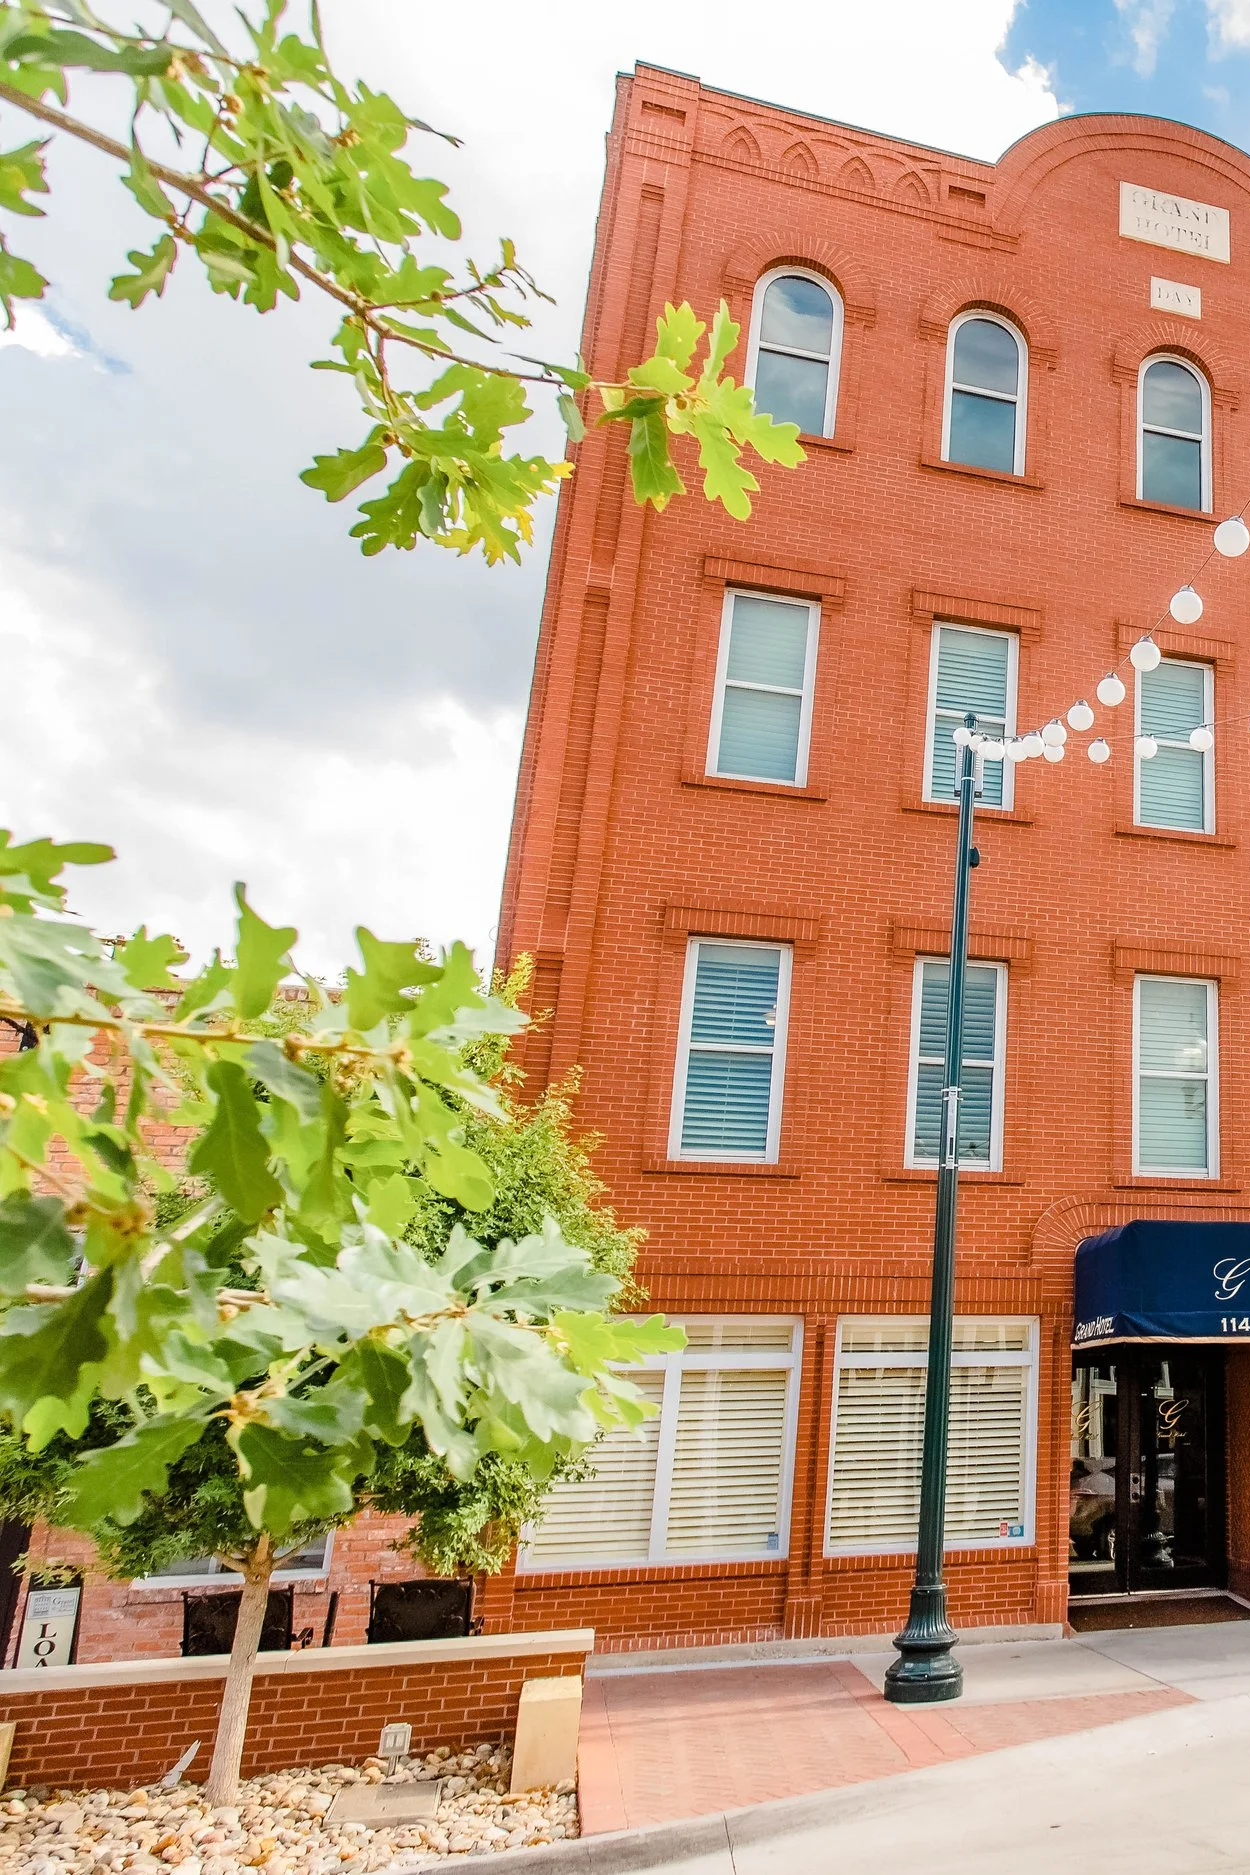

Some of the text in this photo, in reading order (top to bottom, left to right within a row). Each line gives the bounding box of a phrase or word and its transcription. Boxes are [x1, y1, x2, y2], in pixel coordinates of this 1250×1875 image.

[1135, 217, 1211, 250] HOTEL
[1157, 287, 1195, 306] DAY
[1221, 1317, 1250, 1332] 114
